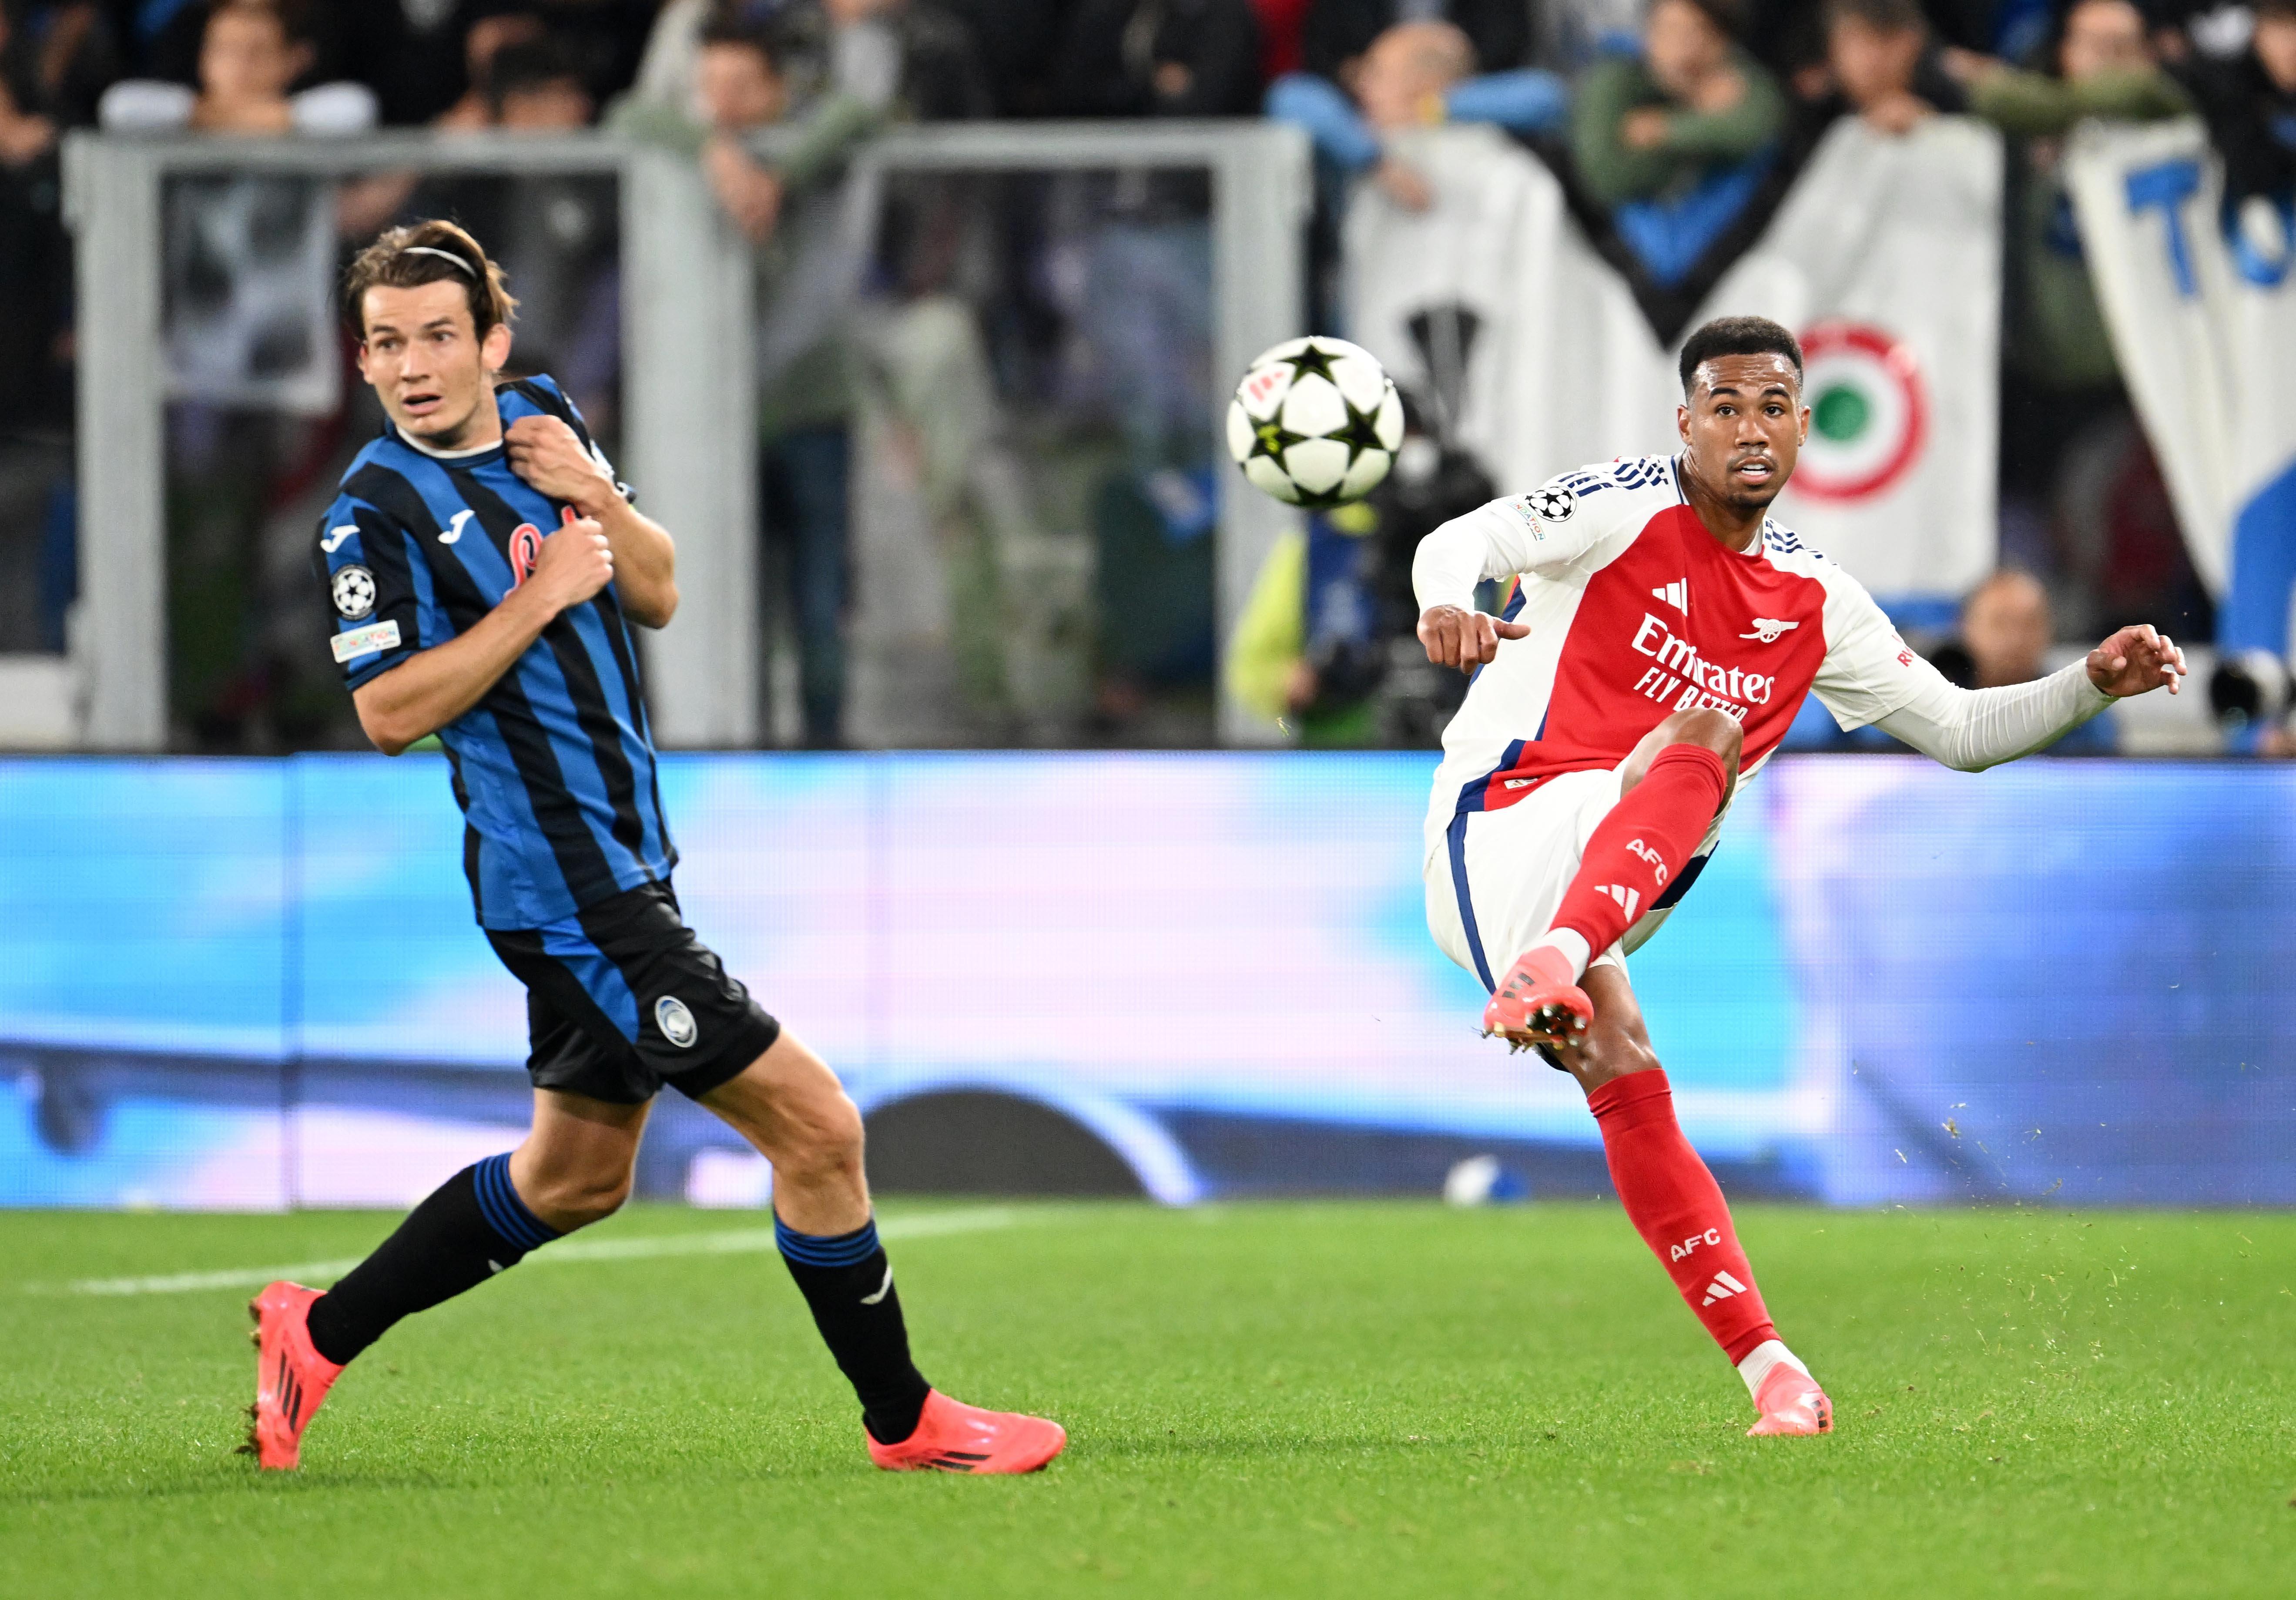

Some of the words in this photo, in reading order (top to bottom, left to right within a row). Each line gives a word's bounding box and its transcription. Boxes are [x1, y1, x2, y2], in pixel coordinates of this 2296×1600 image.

[1509, 501, 1545, 541] UNDATION
[1631, 612, 1775, 705] Emirates
[1633, 666, 1681, 703] FLY
[1625, 838, 1668, 886] AFC
[1670, 1228, 1721, 1262] AFC
